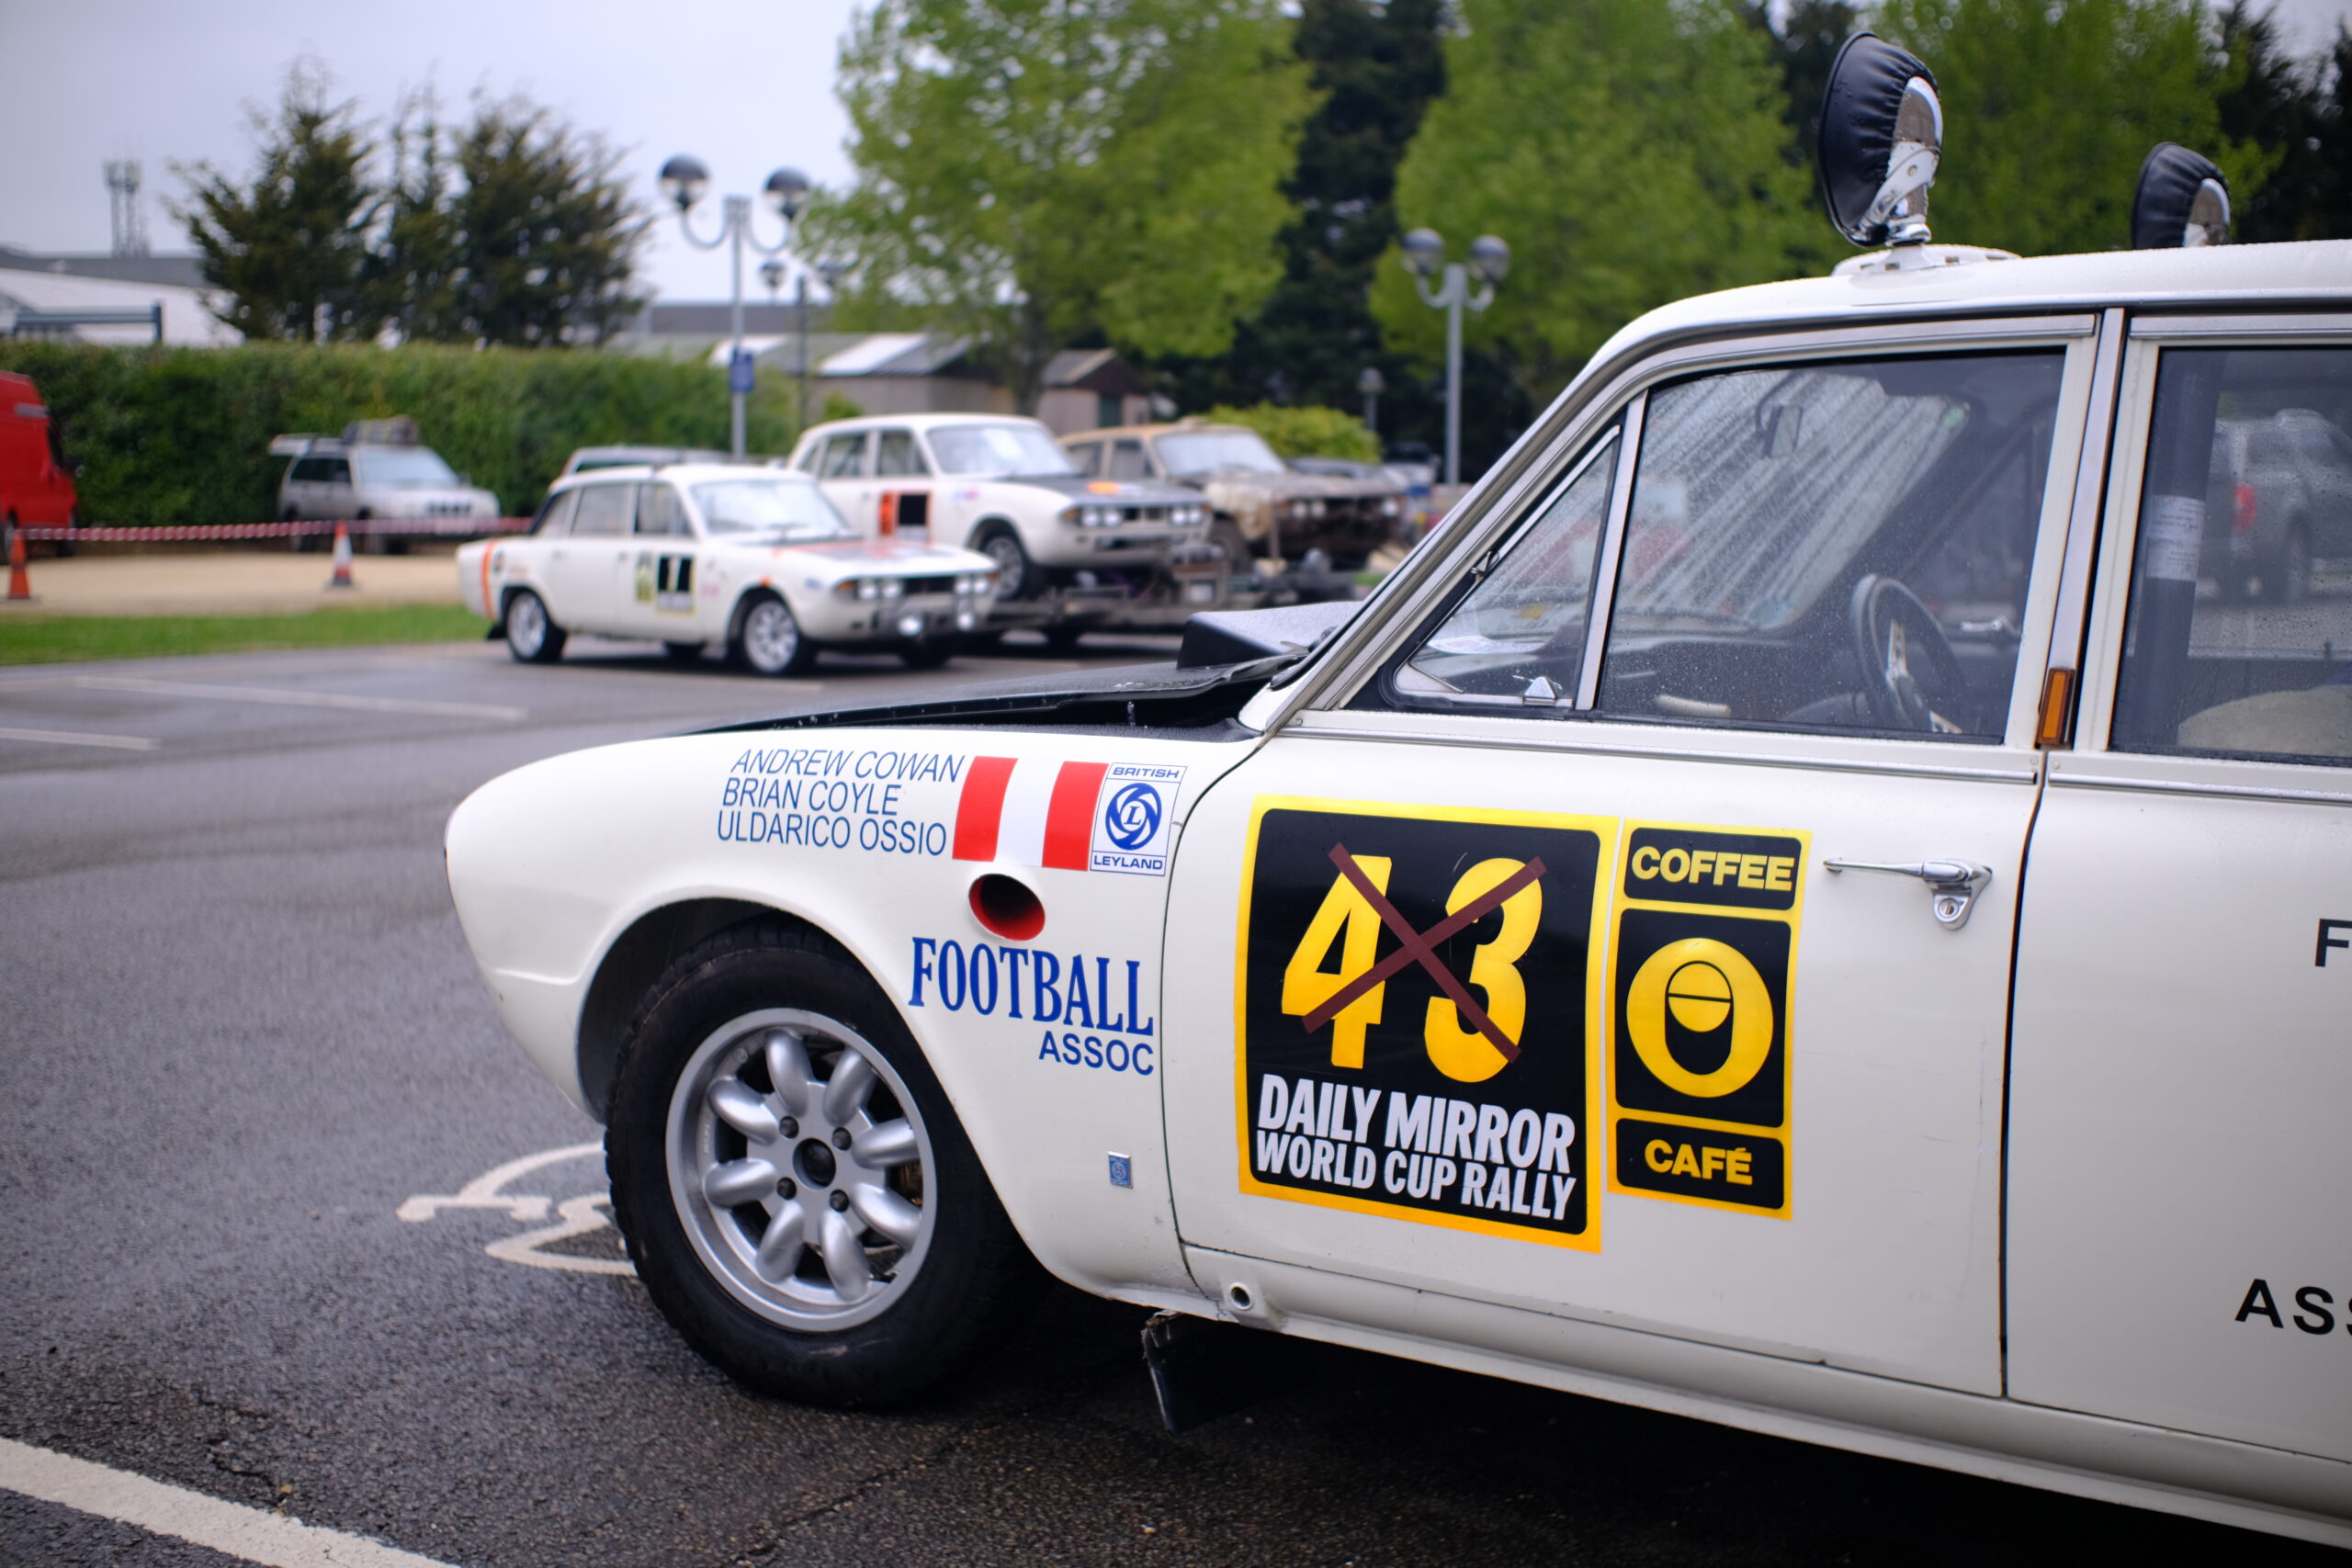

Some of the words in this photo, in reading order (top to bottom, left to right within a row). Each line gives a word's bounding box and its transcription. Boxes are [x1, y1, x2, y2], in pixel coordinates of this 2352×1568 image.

[731, 749, 853, 776] ANDREW
[854, 751, 965, 782] COWAN
[1113, 767, 1179, 778] BRITISH
[722, 777, 801, 808] BRIAN
[808, 781, 901, 816] COYLE
[1123, 806, 1142, 826] L
[718, 811, 850, 849] ULDARICO
[859, 818, 946, 856] OSSIO
[1093, 854, 1164, 871] LEYLAND
[1632, 847, 1795, 891] COFFEE
[907, 937, 1154, 1036] FOOTBALL
[1282, 854, 1542, 1082] 43
[1038, 1031, 1154, 1076] ASSOC
[1259, 1075, 1381, 1143] DAILY
[1385, 1092, 1575, 1173] MIRROR
[1258, 1131, 1375, 1189] WORLD
[1385, 1151, 1456, 1200] CUP
[1462, 1162, 1576, 1220] RALLY
[1645, 1140, 1752, 1185] CAFÉ
[2234, 1278, 2352, 1337] AS
